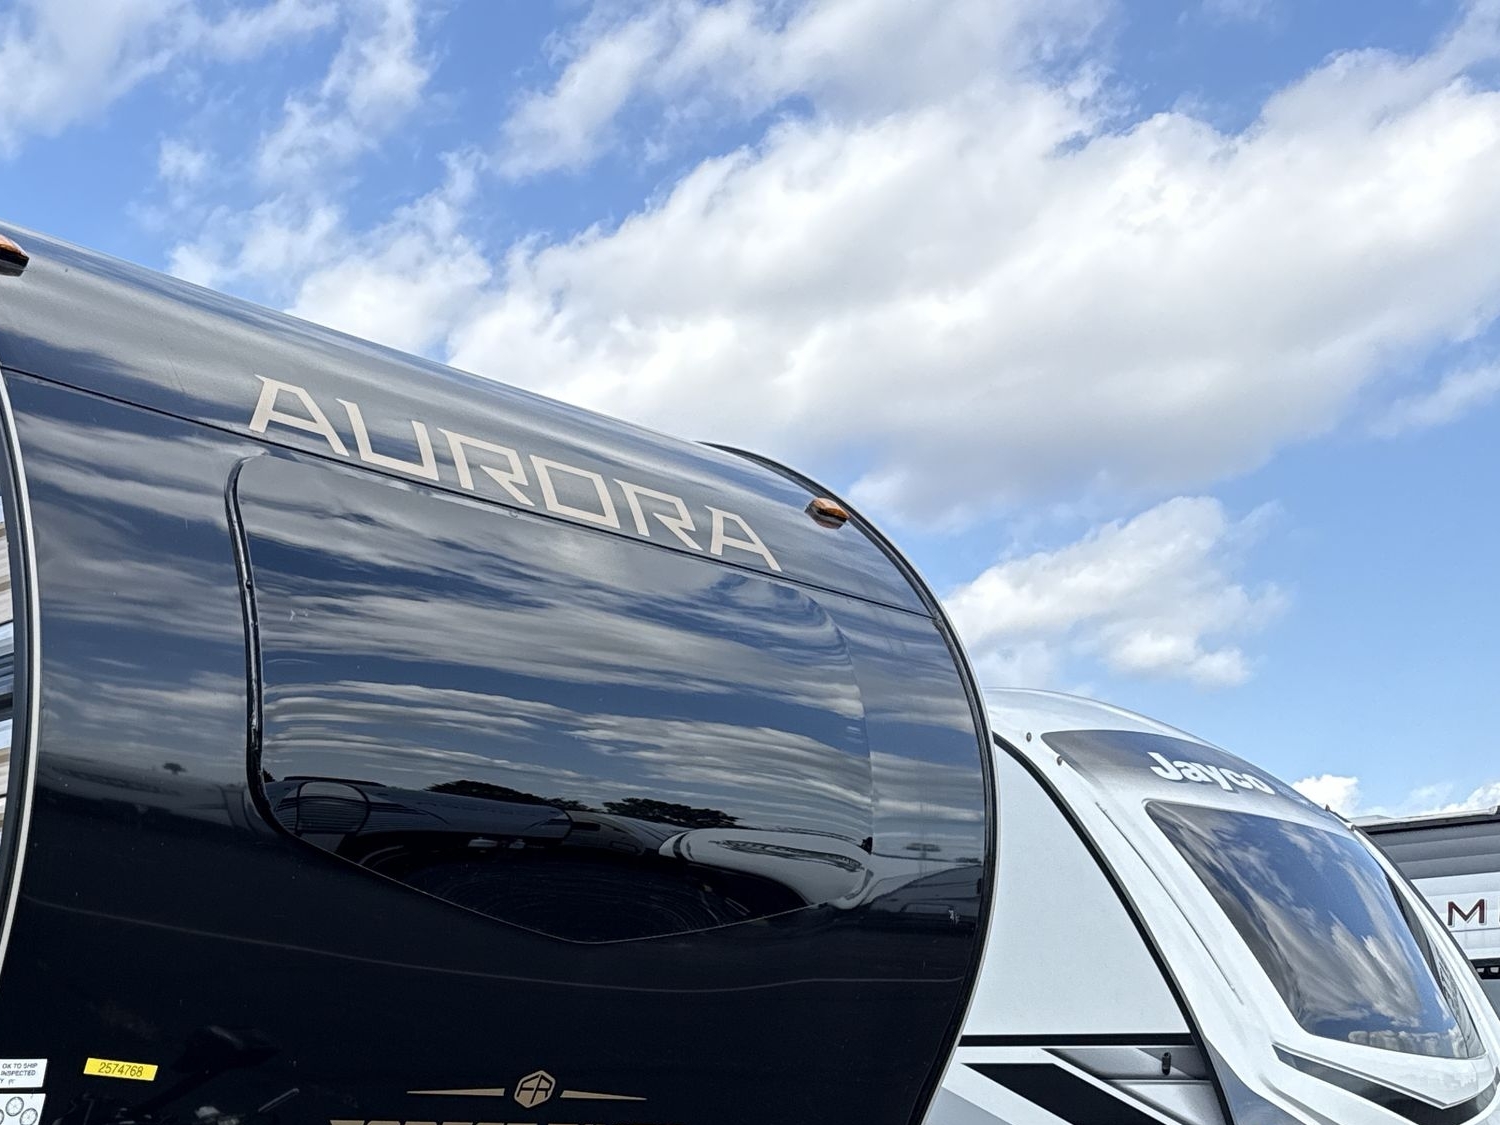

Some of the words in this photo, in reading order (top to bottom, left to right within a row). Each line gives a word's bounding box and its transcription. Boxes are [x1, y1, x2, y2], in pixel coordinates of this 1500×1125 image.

[249, 373, 782, 572] AURORA
[1146, 751, 1276, 795] Jayco
[98, 1061, 144, 1078] 2574768
